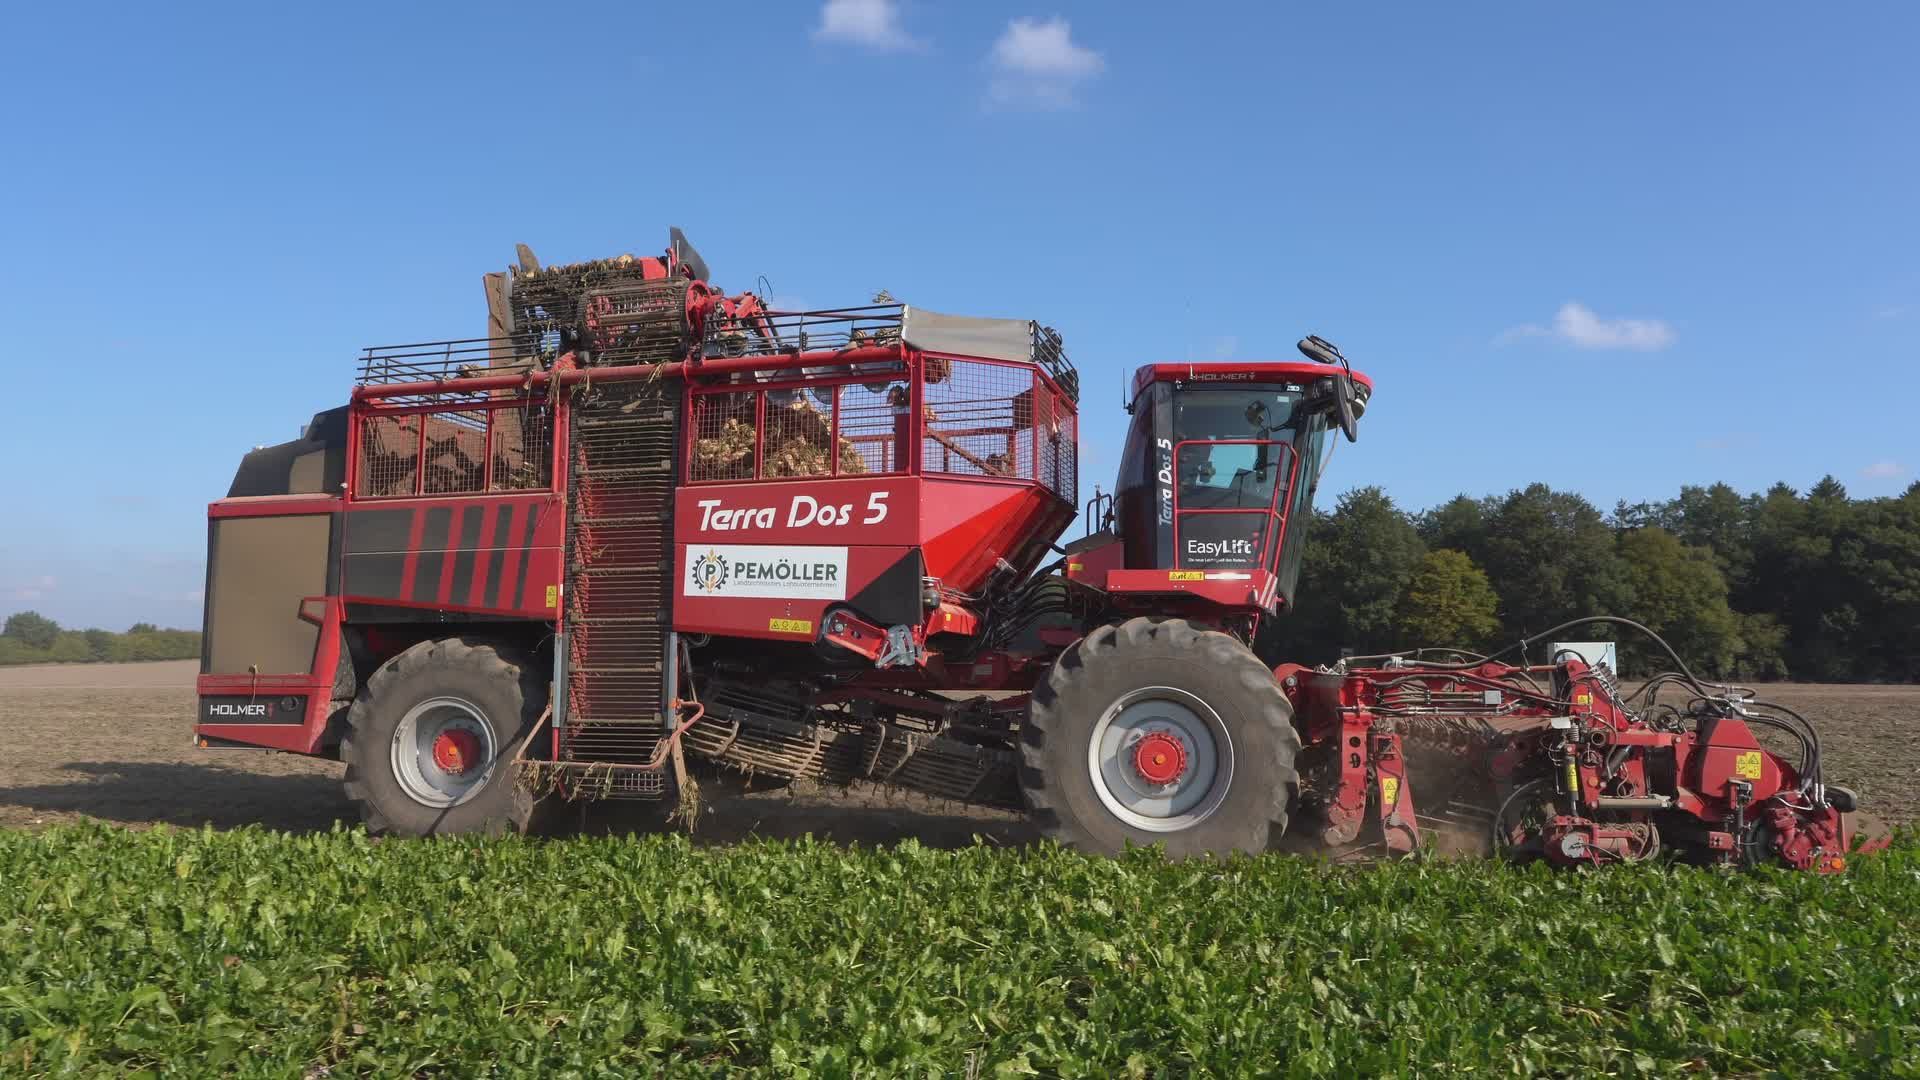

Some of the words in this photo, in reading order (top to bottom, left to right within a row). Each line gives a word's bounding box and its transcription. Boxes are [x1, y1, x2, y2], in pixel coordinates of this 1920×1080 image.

[1195, 373, 1248, 381] HOLMER
[1157, 438, 1172, 450] 5
[1158, 454, 1172, 484] Dos
[698, 499, 776, 531] Terra
[787, 495, 852, 527] Dos
[863, 492, 888, 524] 5
[1158, 488, 1172, 525] Terra
[1187, 539, 1252, 557] EasyLift
[705, 564, 716, 581] P
[734, 558, 838, 581] PEMÖLLER
[210, 704, 265, 715] HOLMER
